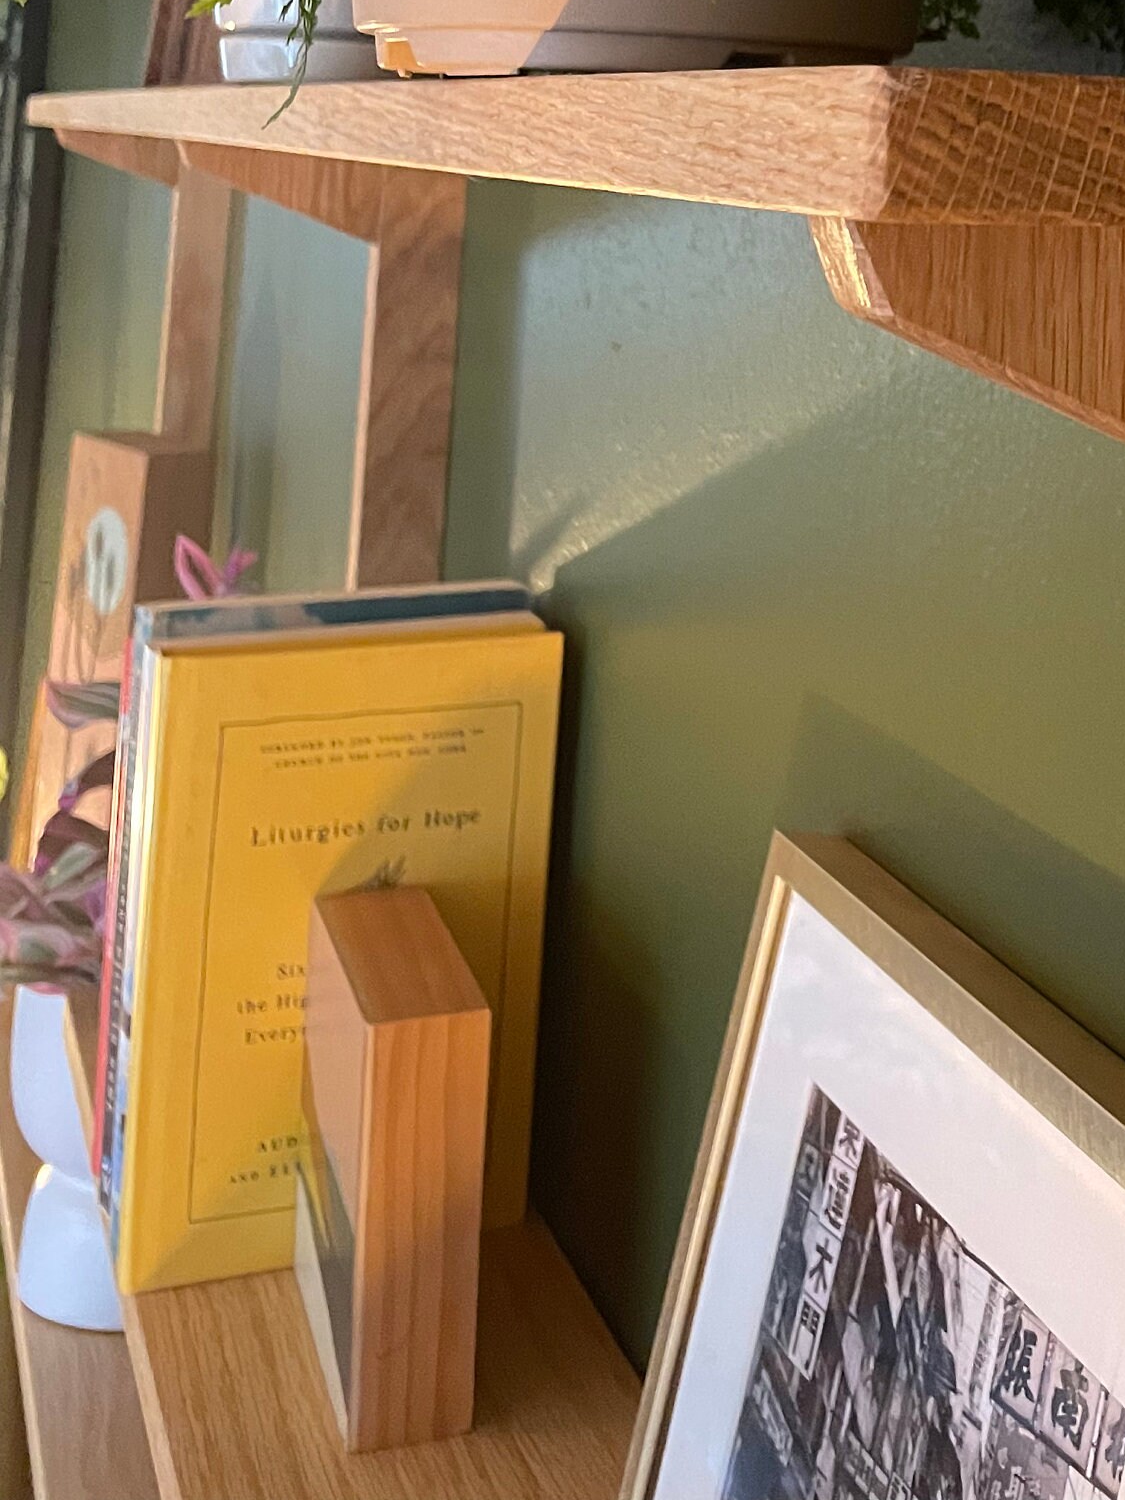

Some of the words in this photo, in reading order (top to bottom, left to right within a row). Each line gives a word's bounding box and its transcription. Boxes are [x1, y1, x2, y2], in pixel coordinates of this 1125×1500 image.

[251, 818, 366, 847] Liturgies
[377, 813, 411, 834] for
[424, 808, 482, 831] Hope
[237, 999, 268, 1015] the
